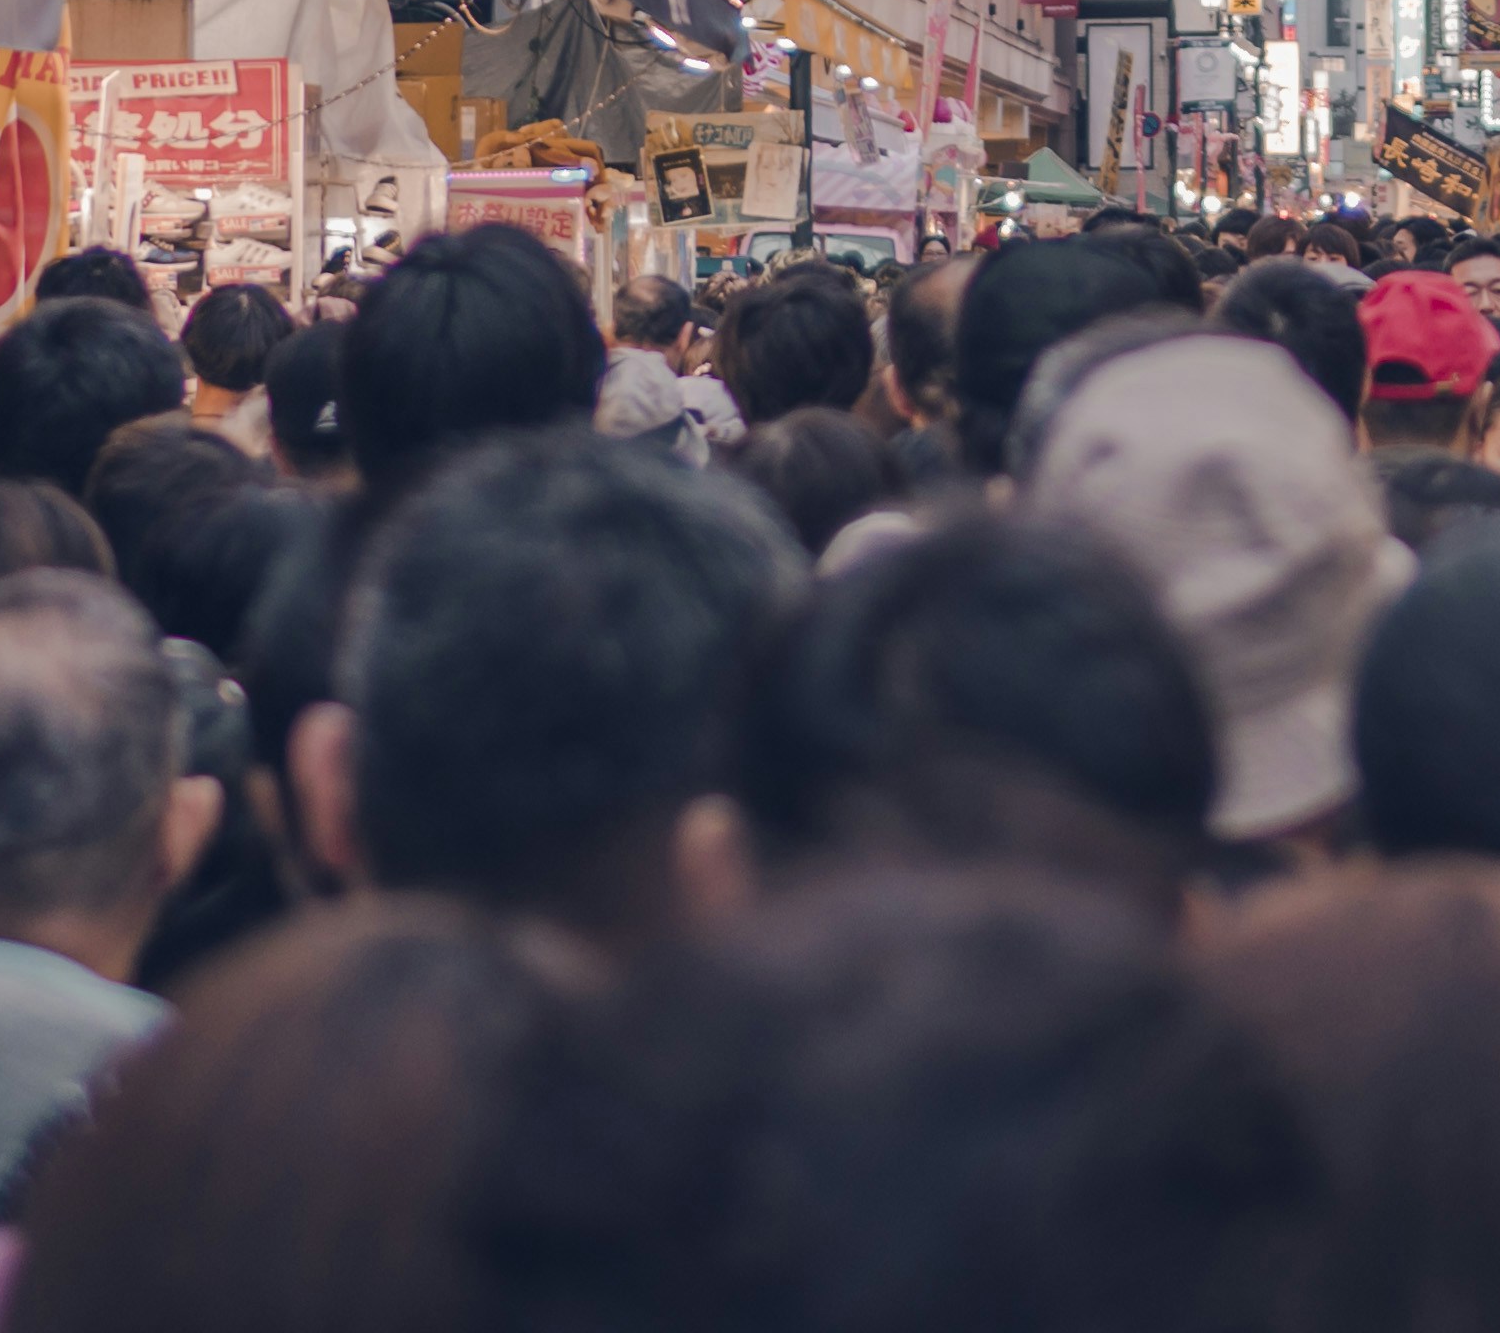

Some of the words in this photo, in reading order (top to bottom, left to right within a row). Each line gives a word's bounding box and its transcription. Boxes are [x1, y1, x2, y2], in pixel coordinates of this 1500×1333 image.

[132, 68, 230, 90] PRICE!!
[221, 217, 250, 231] SALE
[211, 267, 242, 280] SALE
